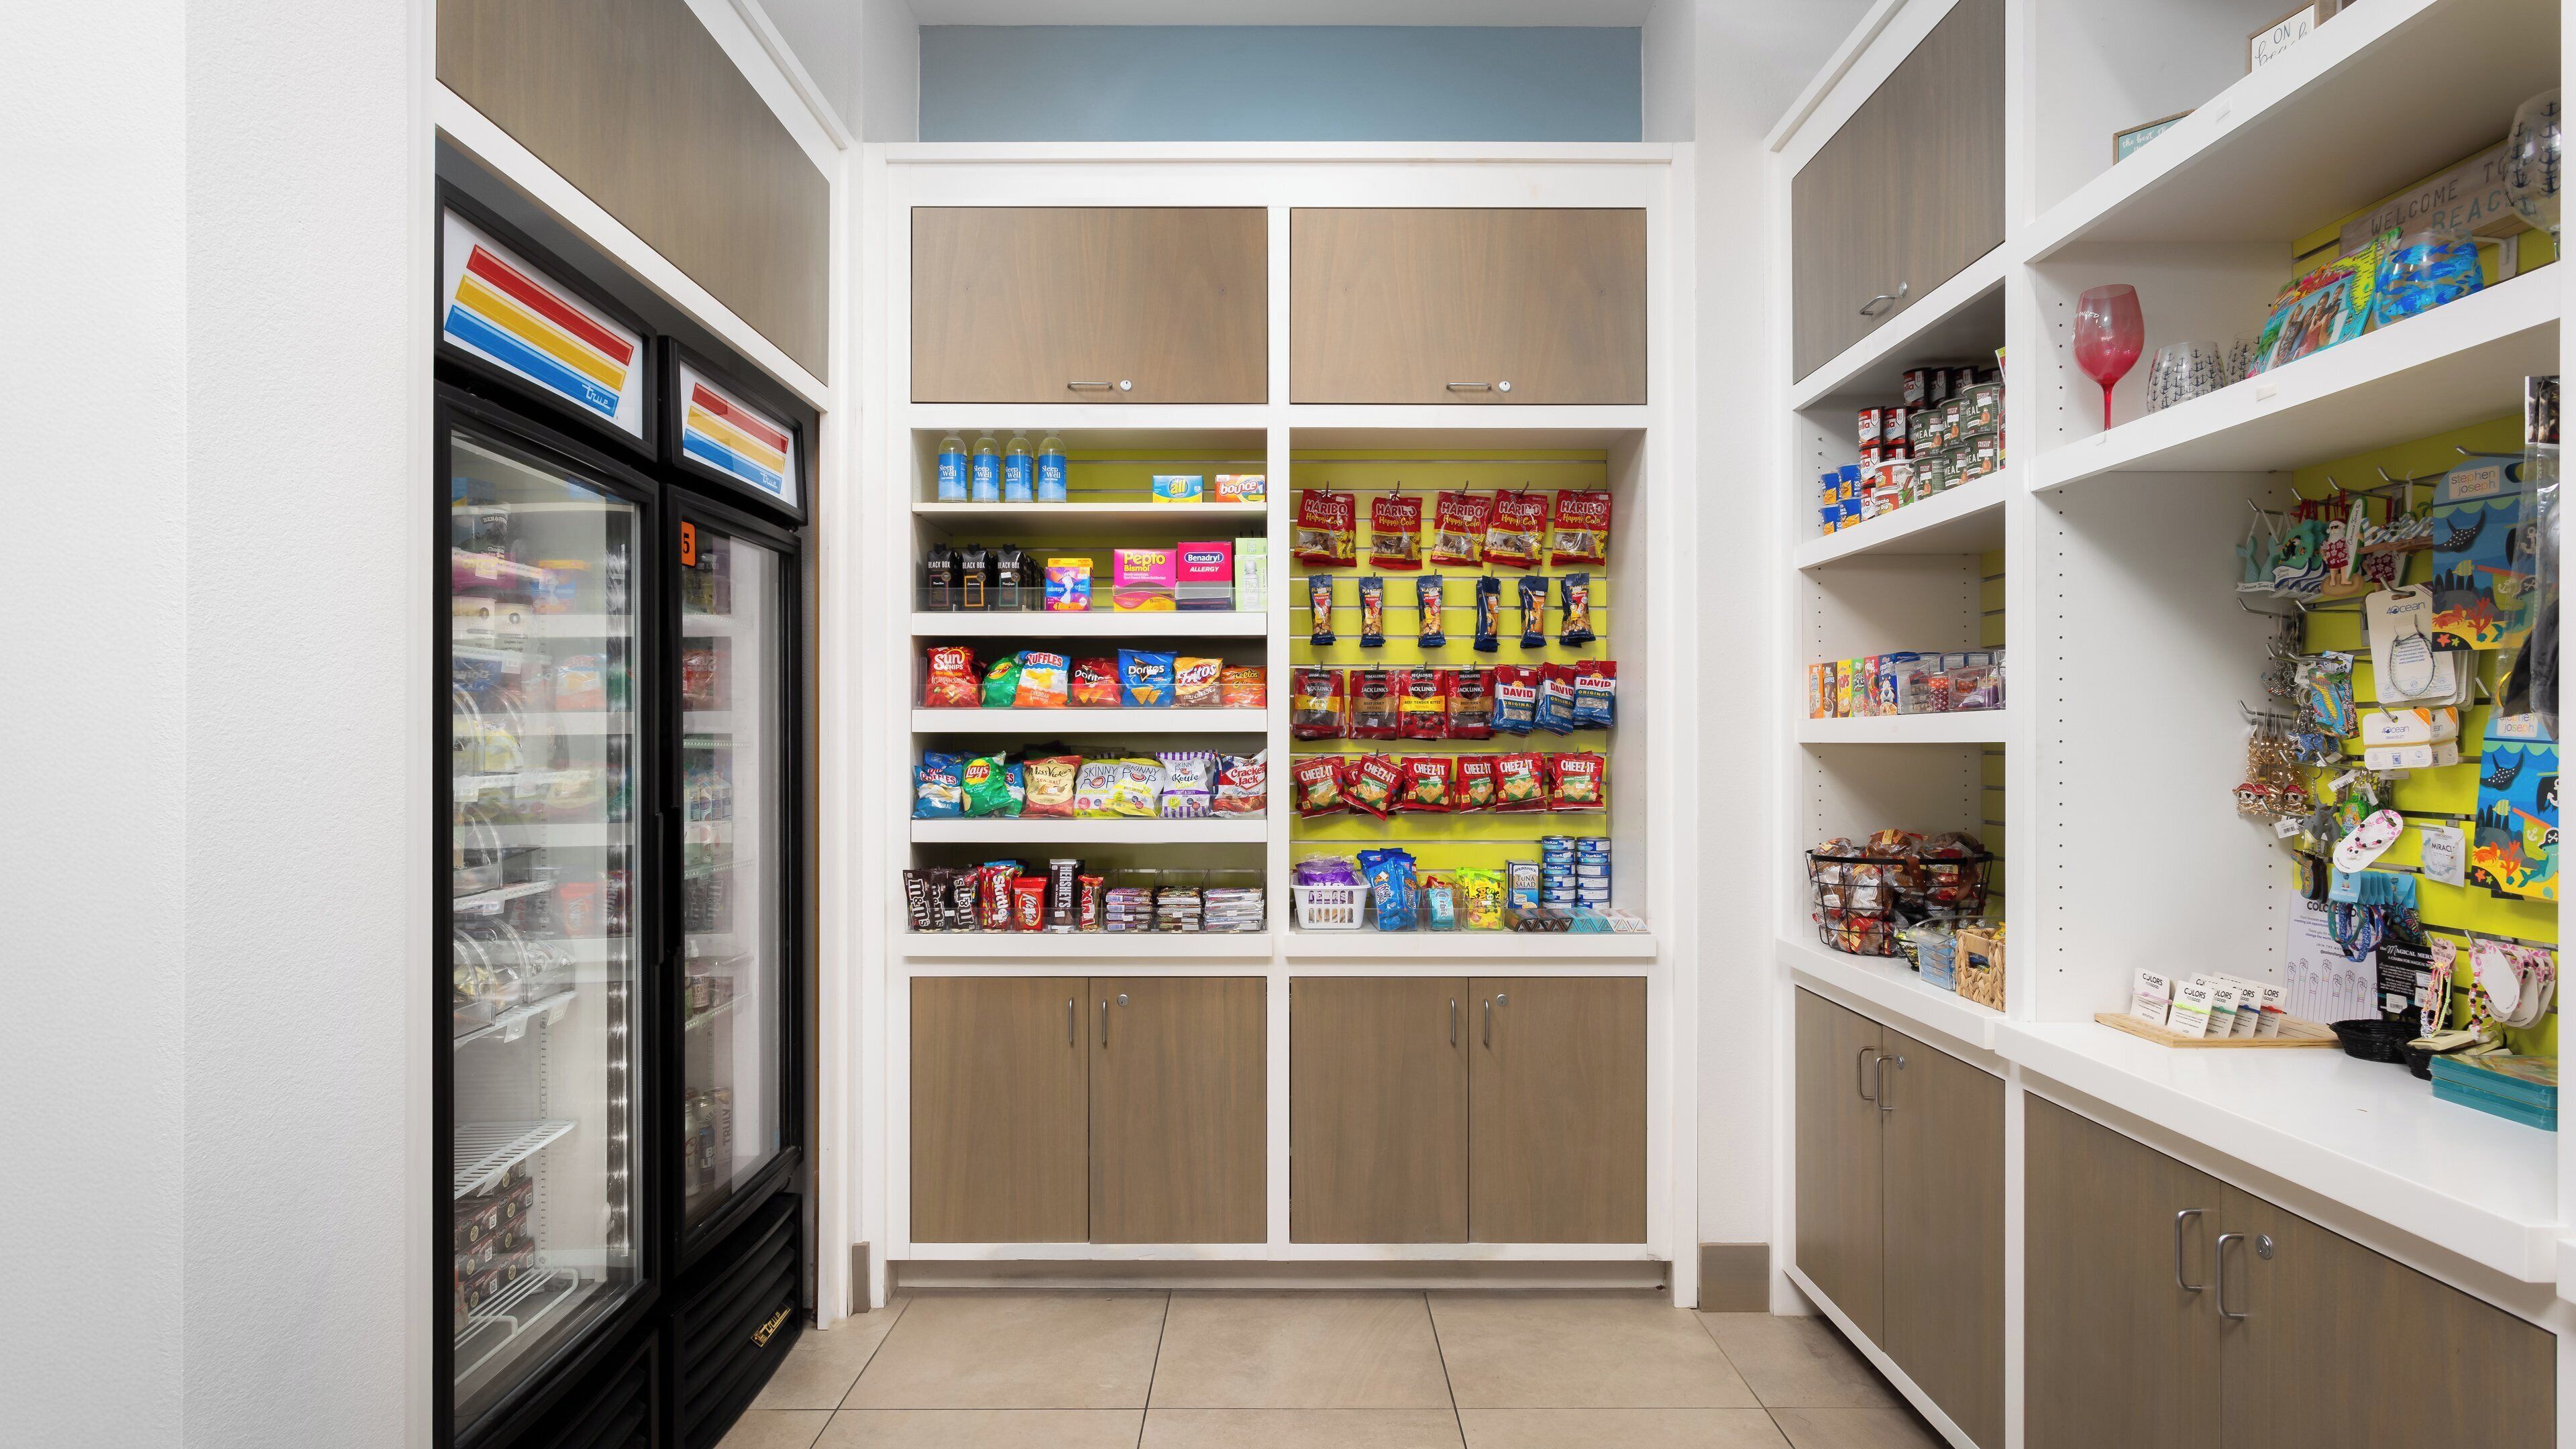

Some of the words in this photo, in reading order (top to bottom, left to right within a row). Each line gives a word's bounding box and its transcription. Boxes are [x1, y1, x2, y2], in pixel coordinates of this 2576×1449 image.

[2273, 21, 2291, 44] ON
[2371, 178, 2459, 236] WELCOME
[2431, 190, 2502, 230] BEAC
[582, 384, 610, 410] true
[938, 465, 955, 474] Sleep
[973, 465, 989, 474] Sleep
[1041, 465, 1059, 474] Sleep
[1046, 471, 1061, 479] Well
[760, 472, 778, 489] true
[2451, 470, 2496, 484] stephen
[1169, 479, 1186, 494] all
[1220, 480, 1258, 496] bounce
[2458, 479, 2496, 496] joseph
[1305, 498, 1348, 515] HARIBO
[1442, 502, 1484, 518] HARIBO
[1560, 500, 1606, 515] HARIBO
[1305, 512, 1327, 524] Happy
[1379, 516, 1399, 526] Happy
[1399, 516, 1415, 525] Cola
[1443, 514, 1464, 526] Happy
[1501, 513, 1521, 526] Happy
[1522, 515, 1538, 525] Cola
[1562, 513, 1584, 525] Happy
[1585, 515, 1601, 525] Cola
[941, 561, 951, 569] BOX
[1124, 551, 1167, 566] Pepto
[1187, 553, 1220, 564] Benadryl
[962, 561, 974, 570] BLACK
[998, 561, 1010, 570] BLACK
[1124, 564, 1151, 572] Bismol
[934, 653, 963, 669] Sun
[1026, 652, 1063, 667] RUFFLES
[1128, 664, 1165, 675] Doritos
[1176, 663, 1216, 687] Fritos
[1550, 683, 1573, 696] DAVID
[1579, 678, 1611, 688] DAVID
[1503, 687, 1534, 698] DAVID
[2343, 683, 2352, 702] Cards
[1550, 696, 1573, 706] ORIGINAL
[2348, 702, 2357, 730] Playing
[2504, 722, 2534, 734] joseph
[965, 765, 991, 780] Lay's
[1083, 766, 1118, 777] SKINNY
[1122, 767, 1157, 784] POP
[1126, 764, 1160, 777] SKINNY
[1231, 766, 1266, 779] Cracker
[1079, 775, 1116, 790] POP
[1234, 775, 1258, 787] Jack
[2431, 843, 2455, 853] MIRACL
[1059, 866, 1071, 908] HERSHEY'S
[2387, 945, 2416, 957] MAGICAL
[2143, 973, 2163, 986] COLORS
[2184, 987, 2206, 1000] COLORS
[2264, 988, 2279, 998] LORS
[722, 1108, 731, 1146] TRULY
